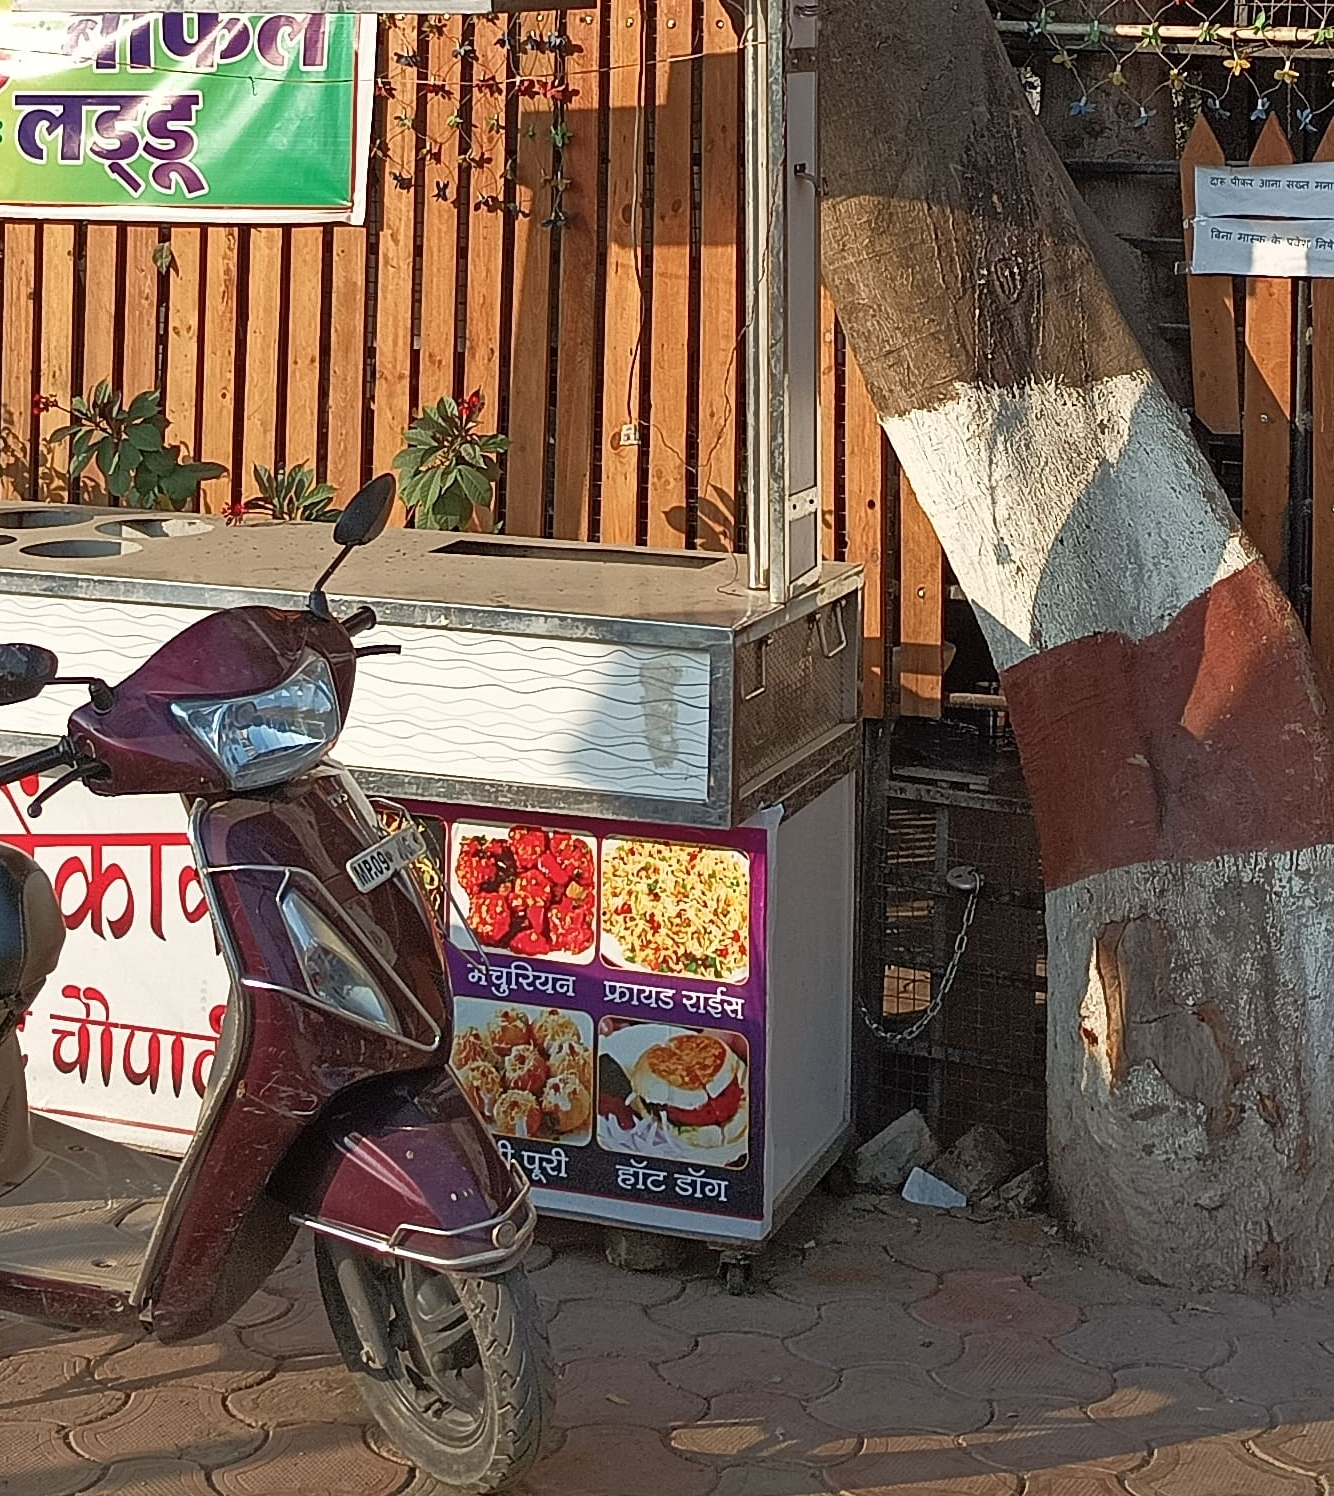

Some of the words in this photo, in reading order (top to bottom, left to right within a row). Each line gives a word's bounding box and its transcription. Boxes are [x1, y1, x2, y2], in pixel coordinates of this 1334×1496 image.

[1259, 179, 1281, 188] आना
[1315, 181, 1333, 190] मना
[1211, 227, 1232, 241] बिना
[604, 980, 674, 1010] फ्रायड
[683, 987, 745, 1019] राईस
[521, 1147, 568, 1184] पूरी
[616, 1159, 667, 1192] हॉट
[674, 1168, 728, 1201] डॉग
